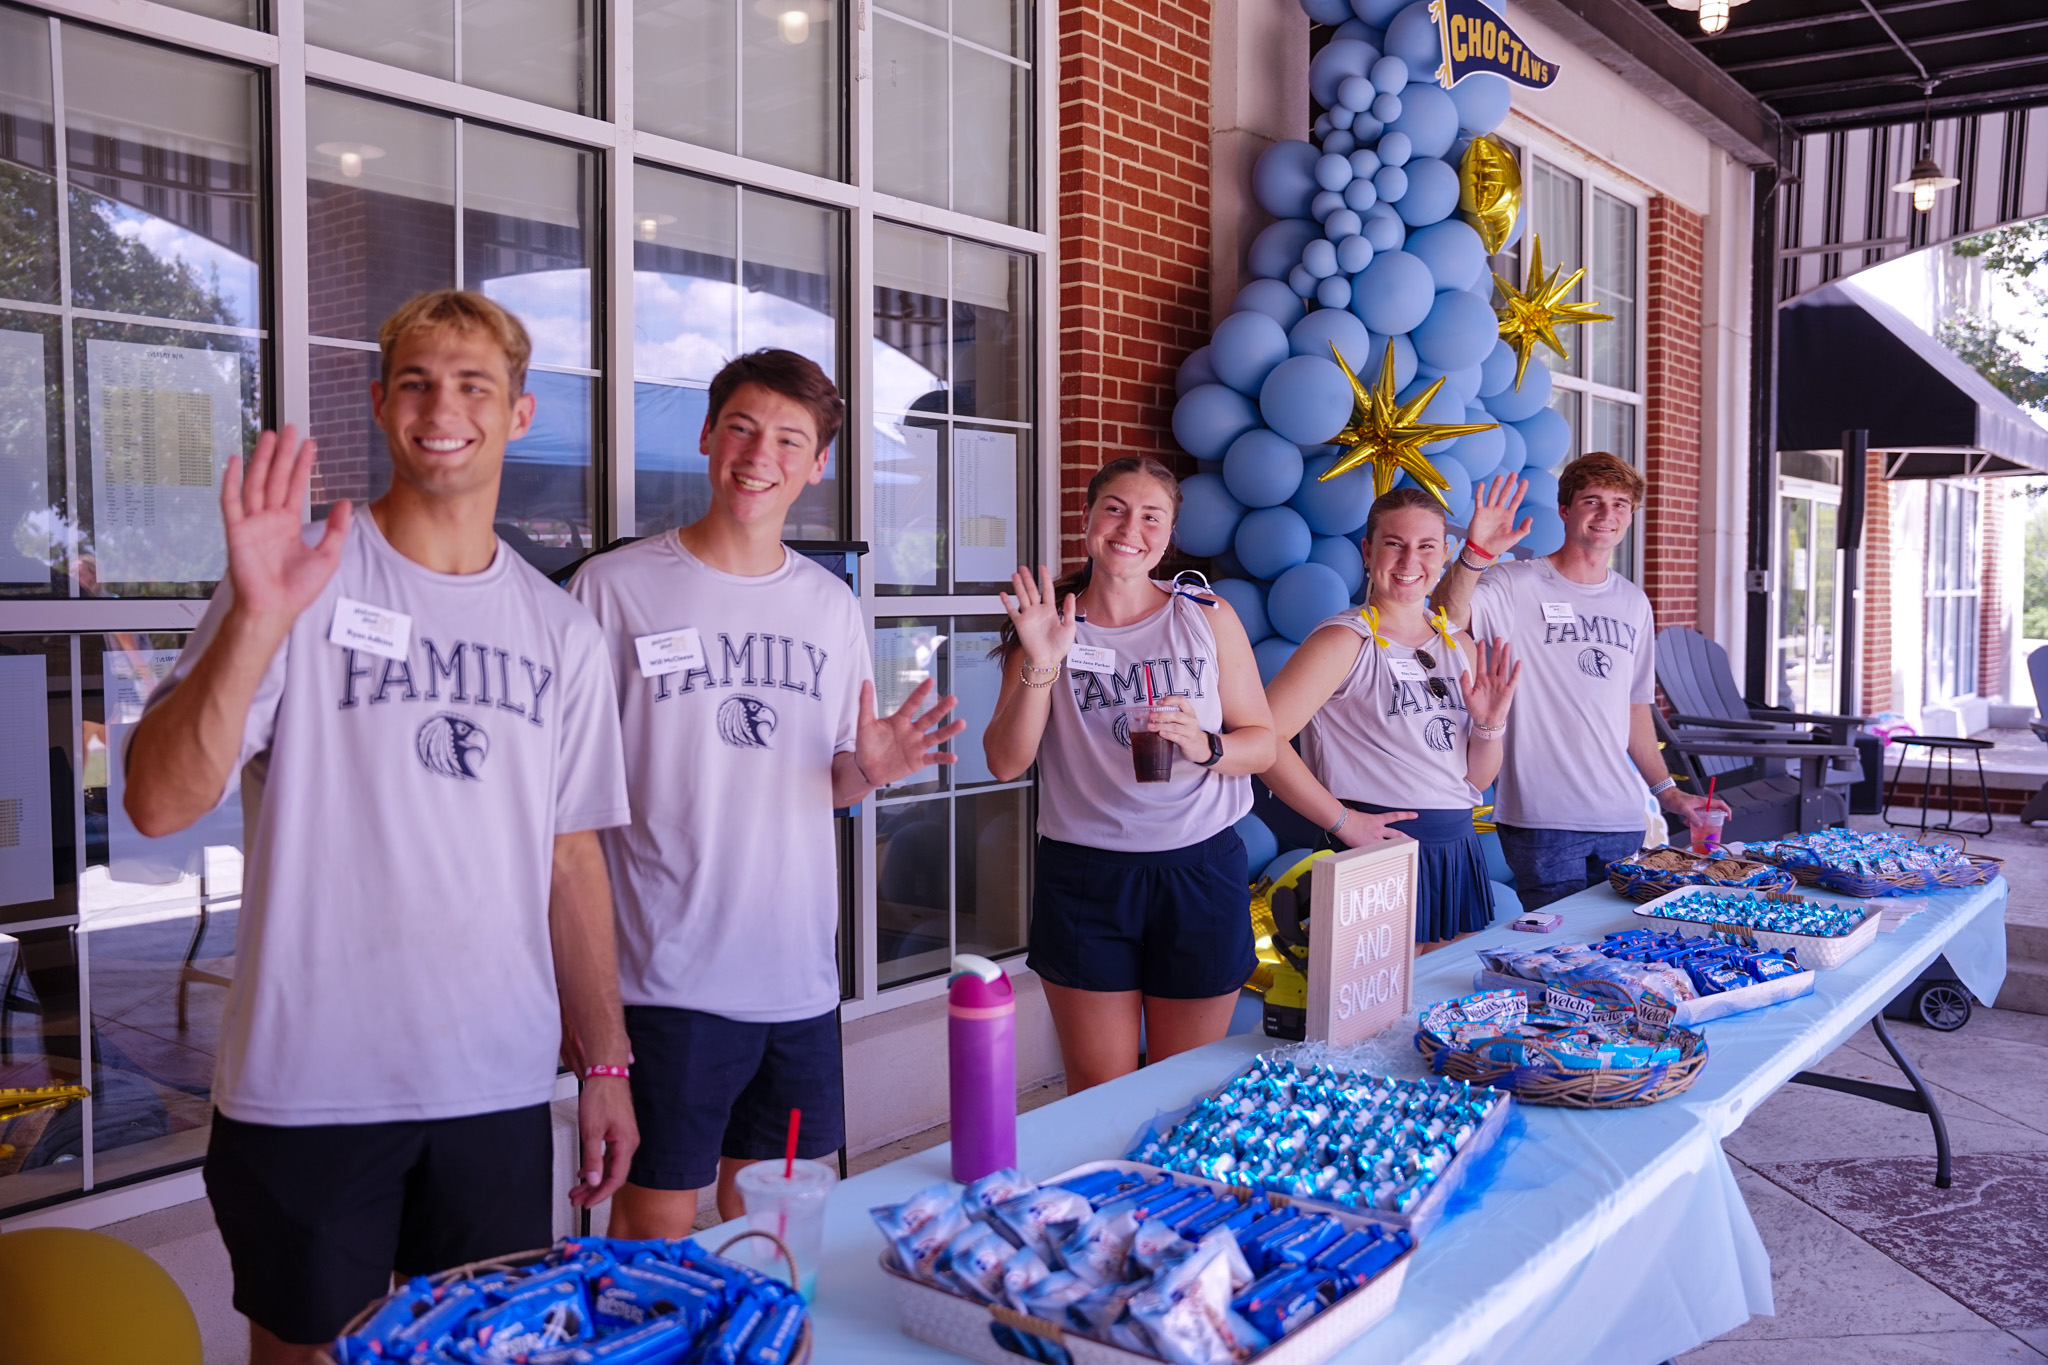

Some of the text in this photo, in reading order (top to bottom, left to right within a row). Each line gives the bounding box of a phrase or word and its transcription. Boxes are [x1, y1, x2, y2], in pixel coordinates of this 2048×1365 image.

[1450, 13, 1549, 84] CHOCTAWS
[1543, 613, 1637, 656] FAMILY
[338, 636, 553, 727] FAMILY
[1071, 657, 1082, 665] Sara
[1094, 661, 1111, 669] Parker
[1339, 872, 1408, 927] UNPACK
[1353, 924, 1392, 969] AND
[1337, 963, 1401, 1021] SNACK
[1549, 992, 1591, 1015] Welch's
[1638, 1004, 1671, 1025] Welch's
